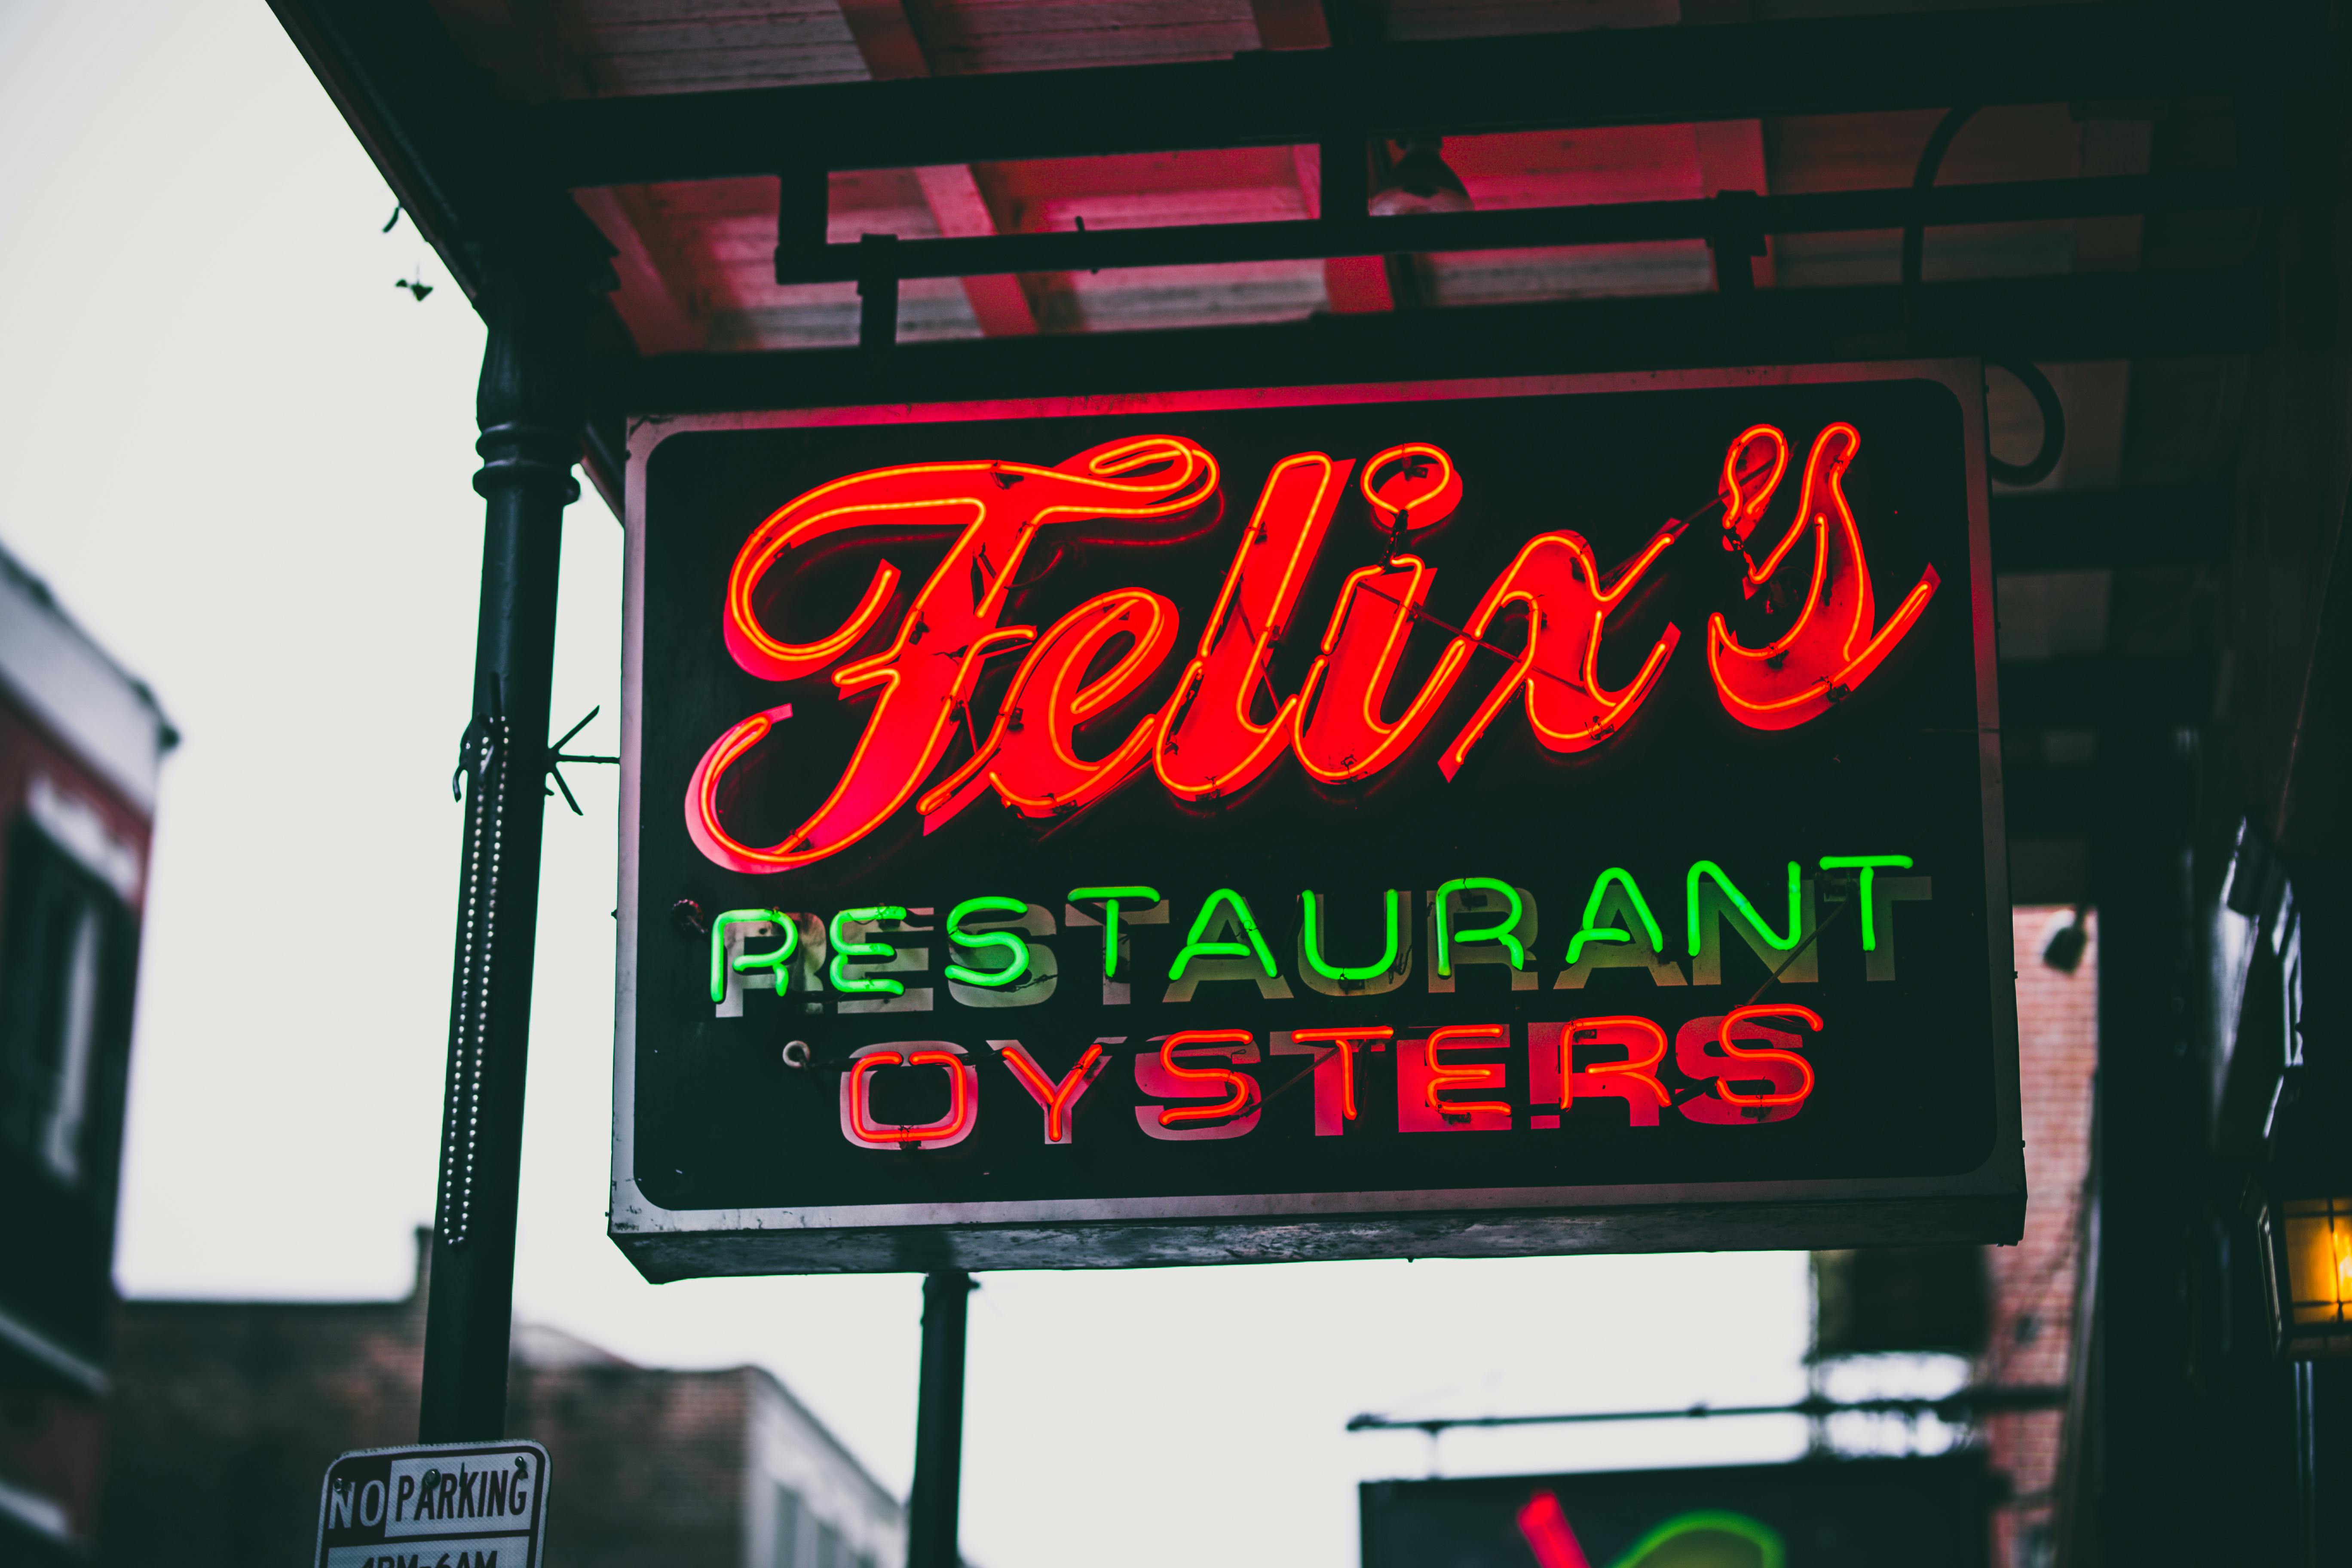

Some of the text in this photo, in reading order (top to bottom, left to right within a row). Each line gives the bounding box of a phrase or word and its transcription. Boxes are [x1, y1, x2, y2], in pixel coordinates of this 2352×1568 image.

[685, 422, 1941, 875] Felix's
[711, 855, 1932, 1018] RESTAURANT
[840, 1003, 1824, 1150] OYSTERS
[328, 1469, 528, 1529] NO PARKING
